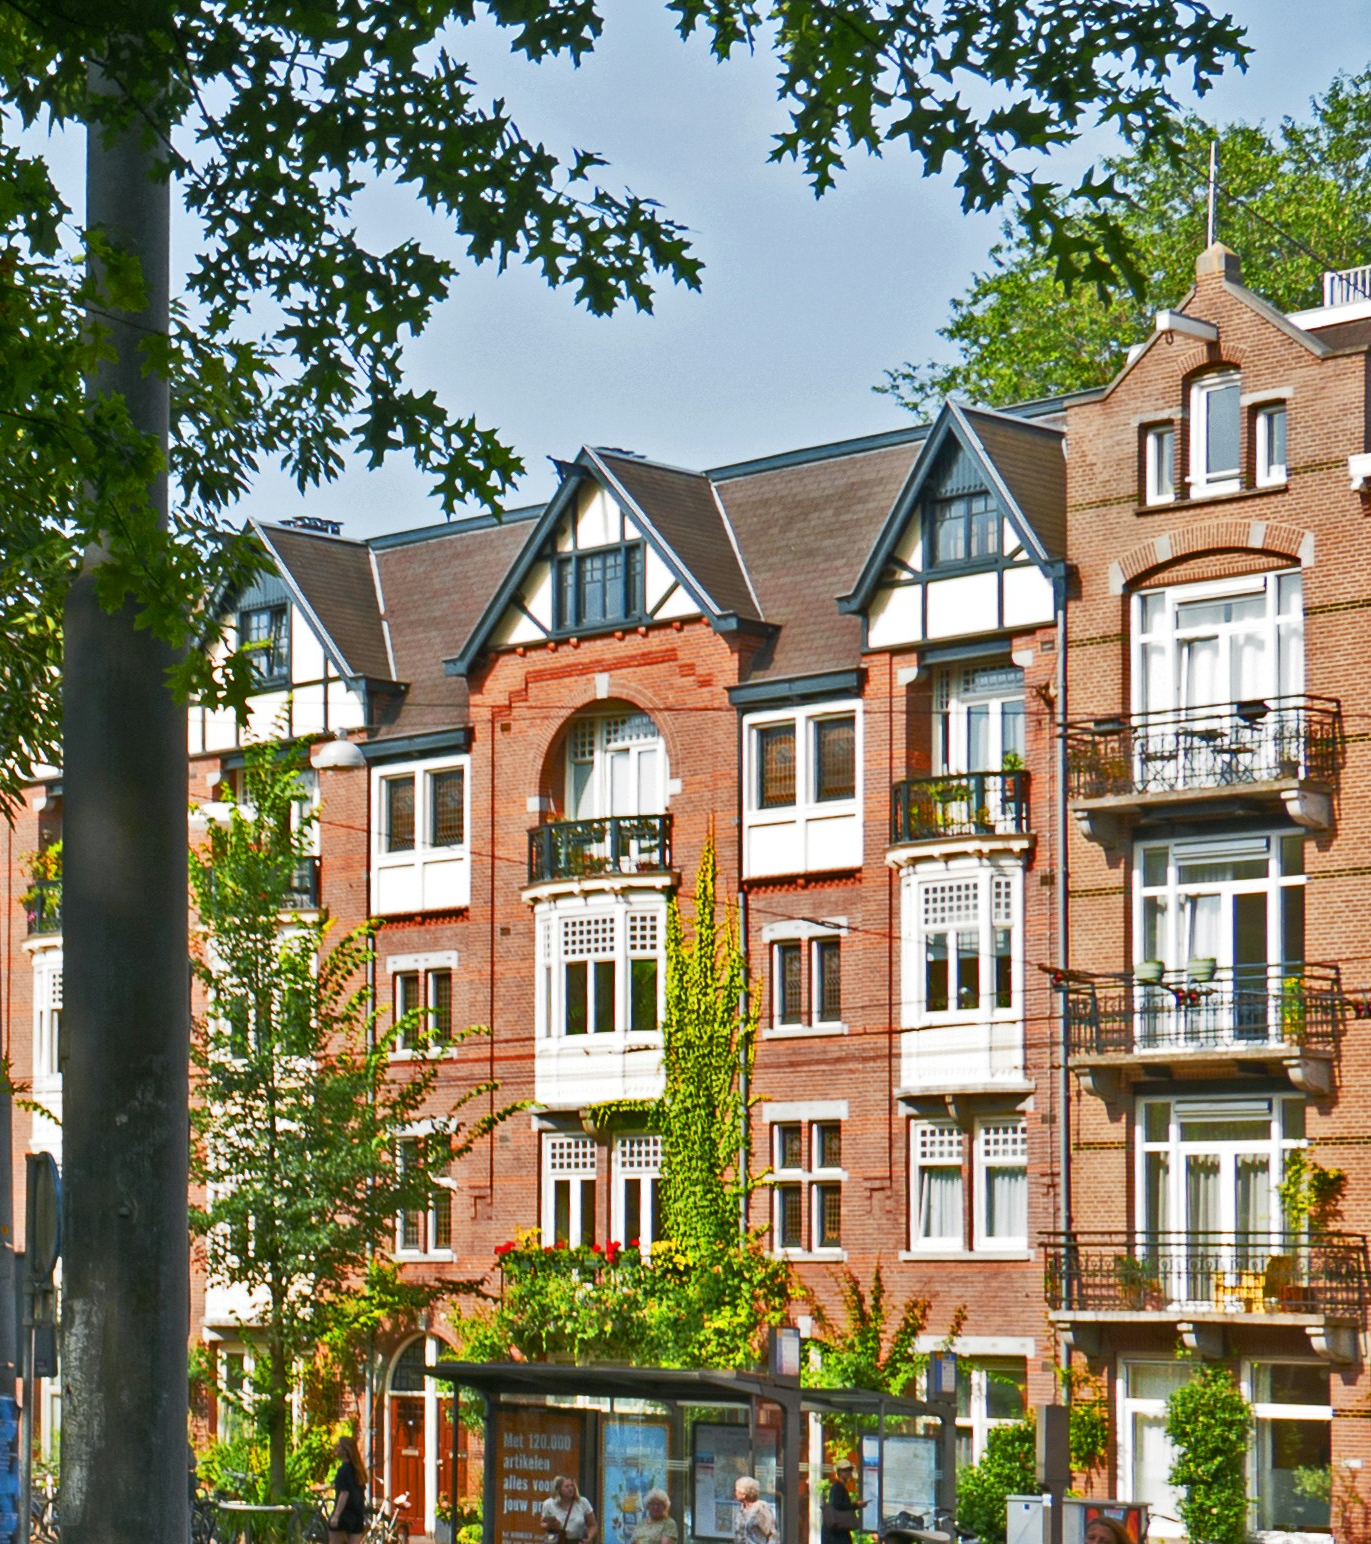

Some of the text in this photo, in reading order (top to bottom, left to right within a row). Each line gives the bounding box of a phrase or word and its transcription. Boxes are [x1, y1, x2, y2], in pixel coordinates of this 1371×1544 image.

[503, 1431, 572, 1450] Met 120.000
[503, 1454, 550, 1471] artikelen
[503, 1474, 528, 1491] alles
[503, 1494, 528, 1515] jouw
